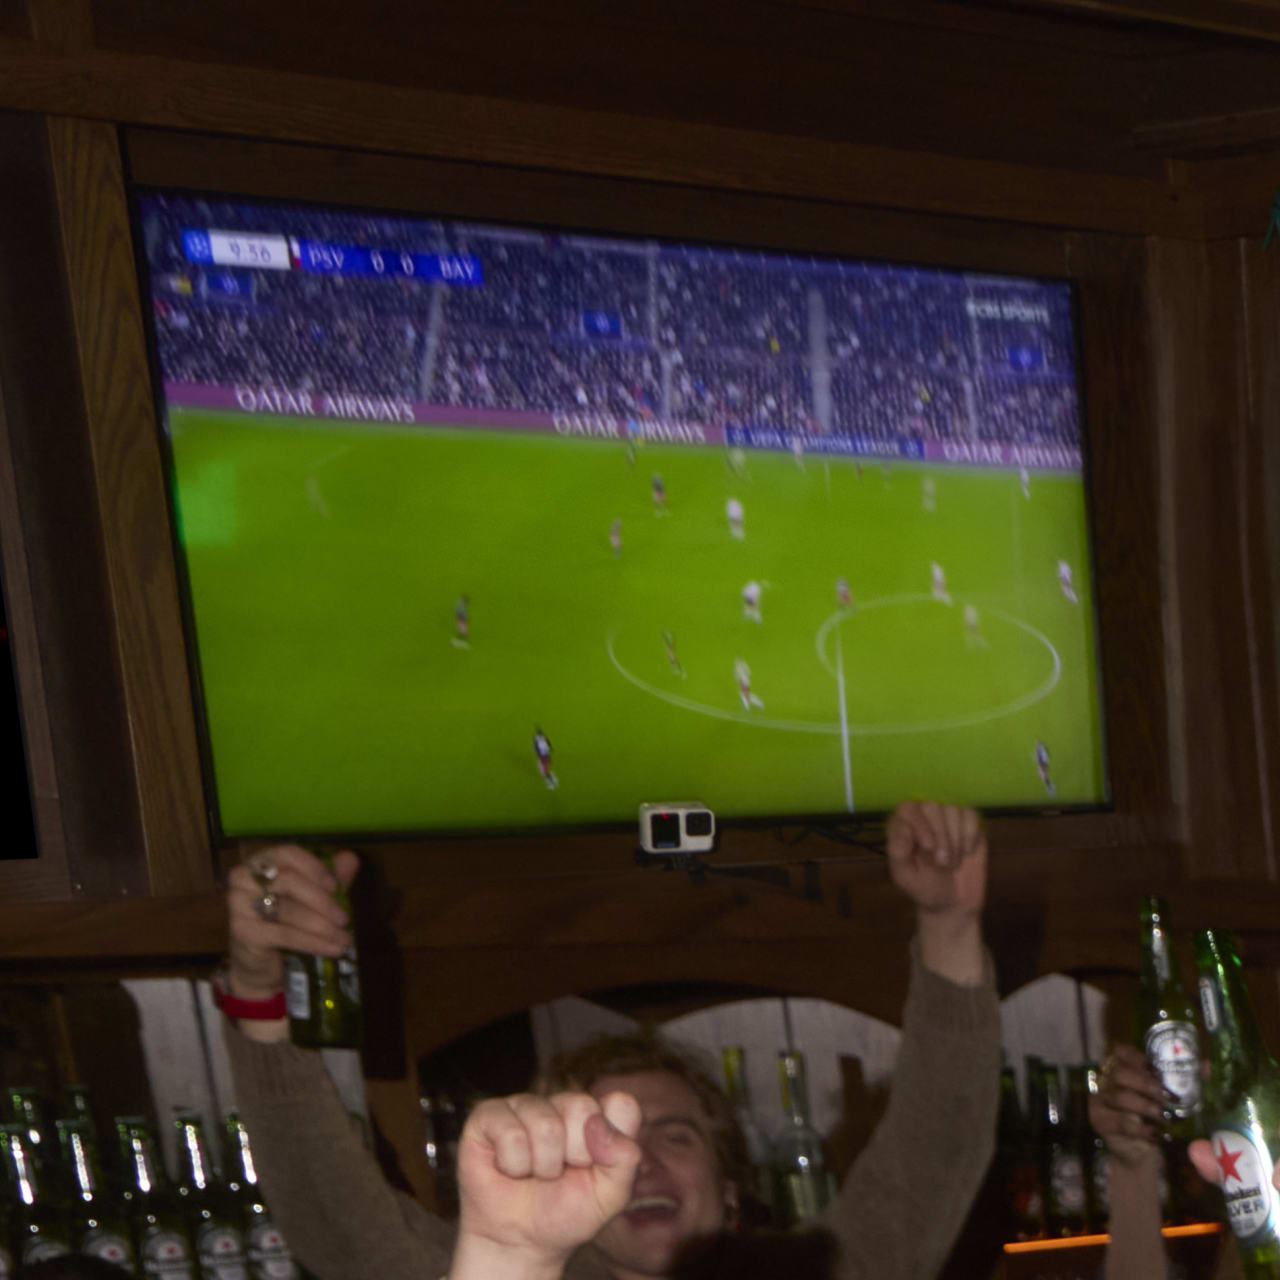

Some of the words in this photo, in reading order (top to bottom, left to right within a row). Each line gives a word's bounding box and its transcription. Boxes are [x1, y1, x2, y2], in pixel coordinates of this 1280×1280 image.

[309, 247, 344, 269] PSV
[438, 257, 475, 280] BAY
[236, 387, 316, 417] QATAR
[322, 394, 416, 424] AIRWAYS
[553, 409, 620, 439] QATAR
